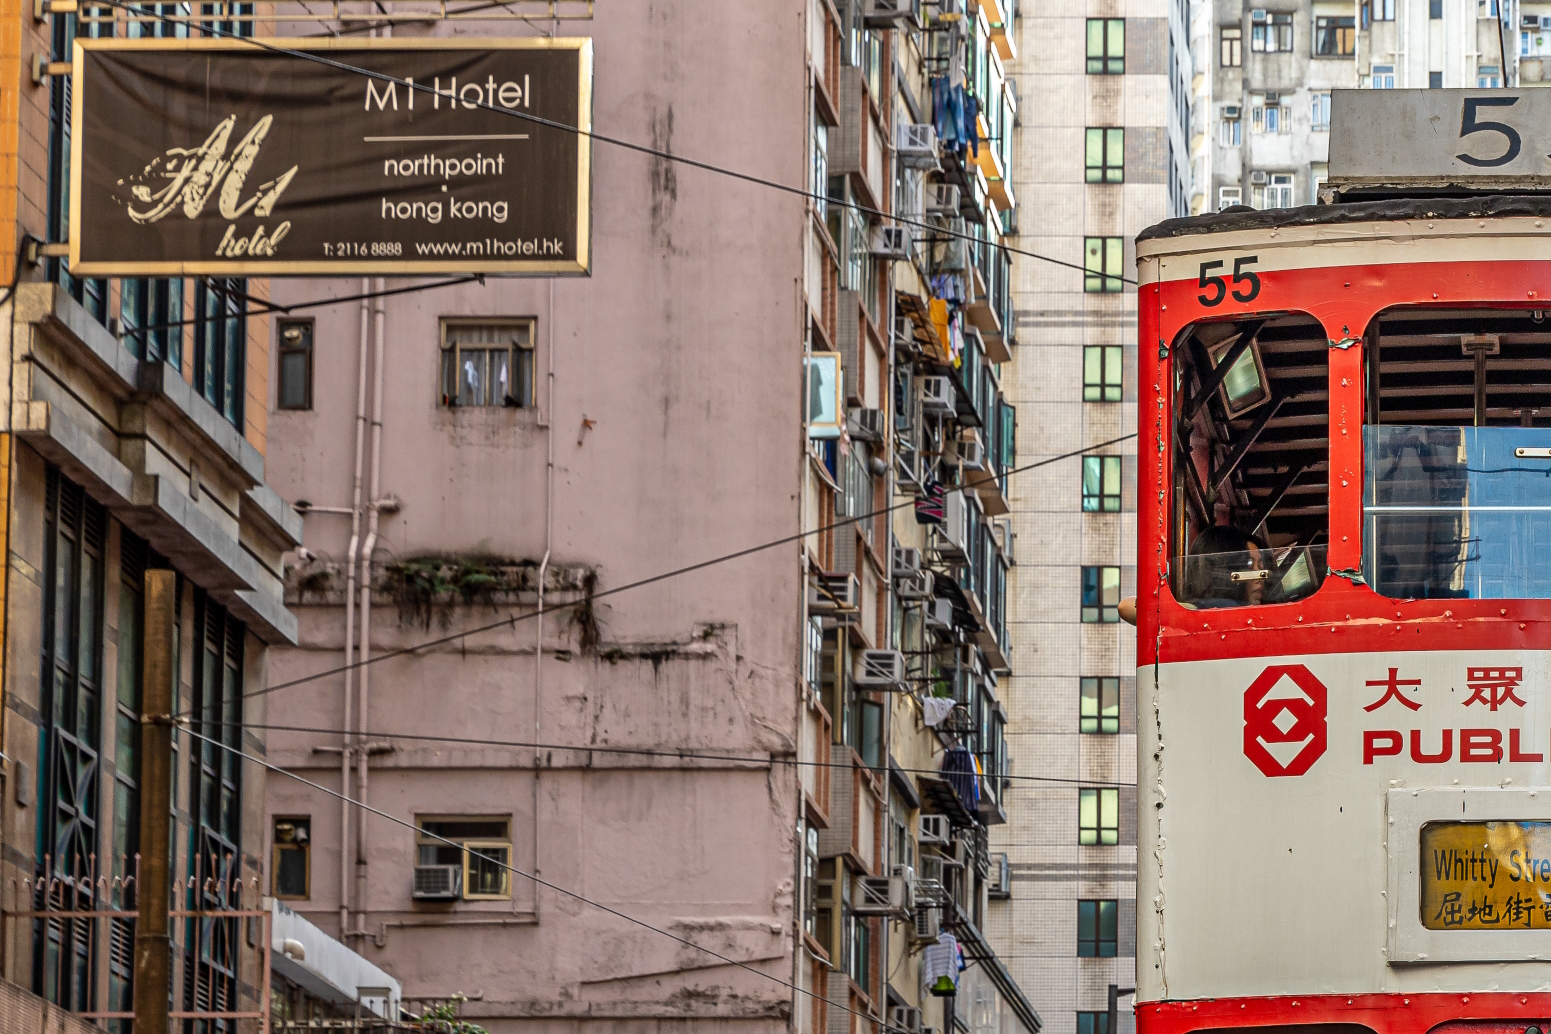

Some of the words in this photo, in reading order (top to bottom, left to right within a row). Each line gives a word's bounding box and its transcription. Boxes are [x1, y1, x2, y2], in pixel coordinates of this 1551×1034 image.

[434, 74, 530, 109] Hotel
[384, 153, 505, 180] northpoint
[381, 196, 442, 223] hong
[449, 196, 509, 222] kong
[214, 220, 292, 257] hotel
[336, 243, 368, 257] 2116
[370, 243, 403, 257] 8888
[415, 237, 564, 256] www.m1hotel.hk
[1197, 255, 1262, 307] 55
[1434, 849, 1499, 889] Whitty
